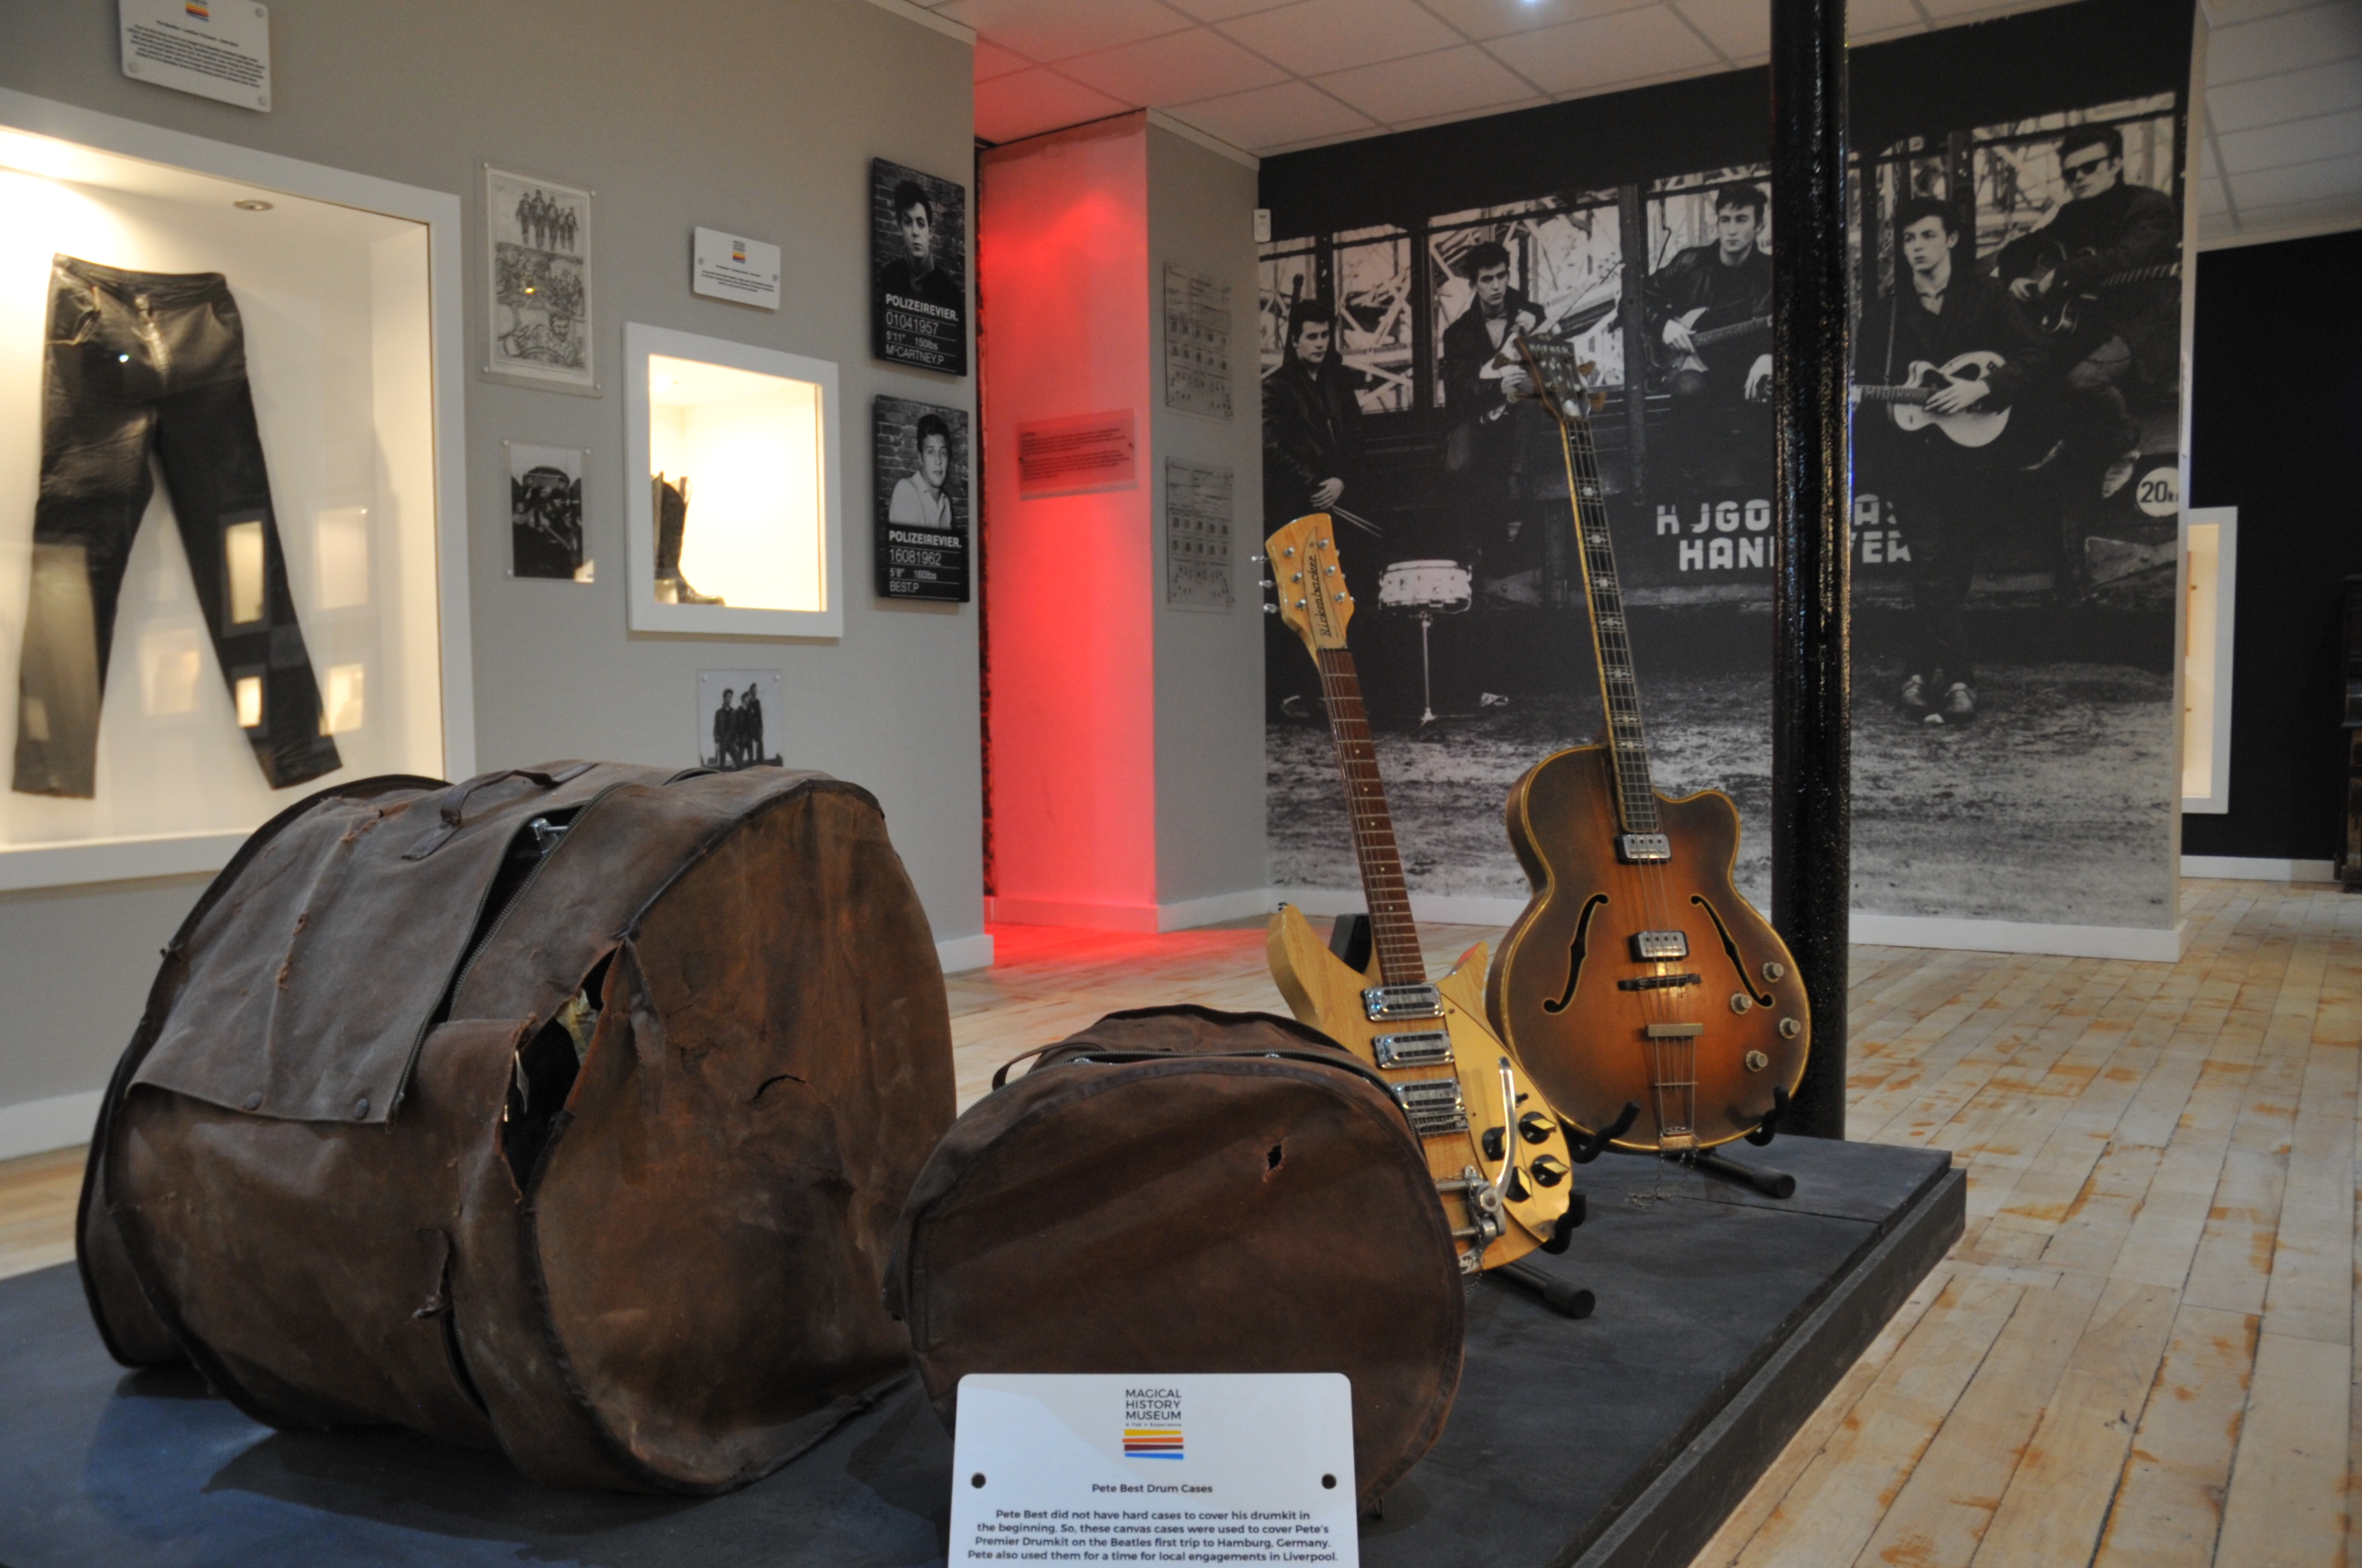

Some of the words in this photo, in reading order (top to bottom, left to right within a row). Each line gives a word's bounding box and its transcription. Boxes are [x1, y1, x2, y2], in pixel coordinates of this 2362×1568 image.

[886, 294, 959, 322] POLIZEIREVIER.
[886, 311, 939, 335] 01041957
[888, 530, 962, 548] POLIZEIREVIER.
[890, 548, 942, 566] 16081962
[1307, 554, 1332, 638] Rickenbacker
[1125, 1388, 1182, 1398] MAGICAL
[1125, 1399, 1181, 1409] HISTORY
[1125, 1410, 1182, 1420] MUSEUM
[1092, 1482, 1117, 1493] Pete
[1120, 1483, 1144, 1493] Best
[1147, 1483, 1178, 1494] Drum
[1181, 1483, 1213, 1494] Cases
[996, 1509, 1021, 1520] Pete
[1023, 1509, 1048, 1520] Best
[1050, 1509, 1069, 1520] did
[1072, 1510, 1090, 1520] not
[1094, 1509, 1120, 1520] have
[1122, 1509, 1149, 1520] hard
[1150, 1511, 1182, 1520] cases
[1184, 1511, 1196, 1520] to
[1198, 1512, 1229, 1520] cover
[1231, 1509, 1248, 1520] his
[1250, 1510, 1296, 1520] drumkit
[1299, 1512, 1310, 1520] in
[977, 1522, 996, 1532] the
[999, 1522, 1057, 1536] beginning.
[1061, 1523, 1077, 1533] So,
[1079, 1523, 1111, 1534] these
[1113, 1525, 1151, 1534] canvas
[1154, 1526, 1184, 1534] cases
[1187, 1526, 1215, 1534] were
[1217, 1524, 1245, 1534] used
[1247, 1524, 1260, 1534] to
[1262, 1526, 1292, 1534] cover
[1295, 1524, 1329, 1534] Pete's
[975, 1536, 1020, 1547] Premier
[1022, 1536, 1069, 1547] Drumkit
[1072, 1538, 1086, 1547] on
[1089, 1537, 1108, 1548] the
[1111, 1537, 1152, 1548] Beatles
[1155, 1537, 1177, 1548] first
[1179, 1537, 1201, 1549] trip
[1202, 1538, 1215, 1548] to
[1217, 1537, 1273, 1550] Hamburg,
[1276, 1537, 1329, 1550] Germany.
[968, 1549, 993, 1560] Pete
[995, 1549, 1018, 1560] also
[1021, 1550, 1048, 1560] used
[1050, 1550, 1081, 1561] them
[1083, 1550, 1100, 1561] for
[1102, 1552, 1109, 1561] a
[1111, 1550, 1138, 1561] time
[1140, 1550, 1156, 1561] for
[1159, 1551, 1185, 1562] local
[1188, 1552, 1267, 1564] engagements
[1269, 1553, 1280, 1561] in
[1283, 1551, 1337, 1564] Liverpool.
